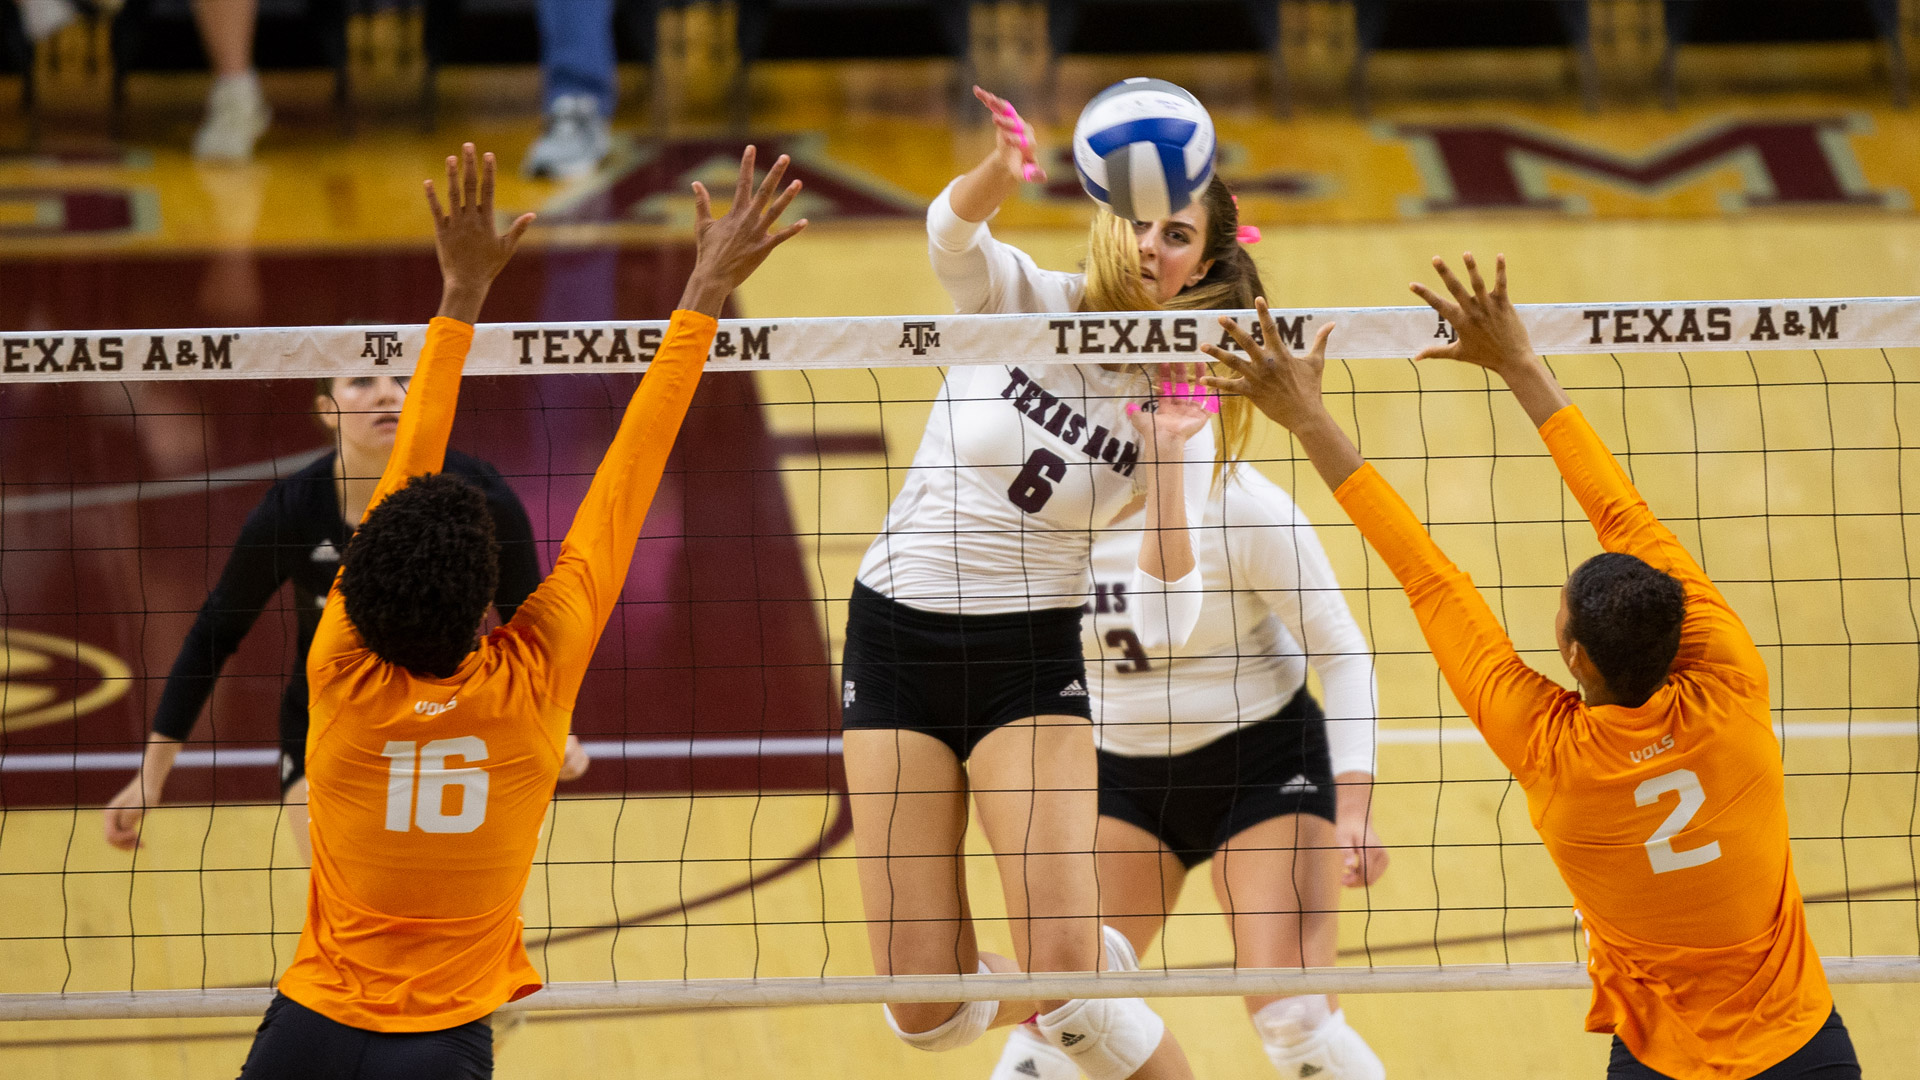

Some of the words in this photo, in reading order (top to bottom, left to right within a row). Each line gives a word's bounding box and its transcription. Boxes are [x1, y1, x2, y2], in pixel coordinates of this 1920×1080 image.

[1049, 318, 1198, 355] TEXAS
[1583, 307, 1731, 344] TEXAS
[1749, 304, 1840, 341] A&M
[142, 334, 233, 370] A&M
[512, 328, 663, 365] TEXAS
[705, 325, 771, 361] &M
[1000, 366, 1087, 445] TEXAS
[1007, 447, 1067, 514] 6
[1105, 628, 1151, 674] 3
[413, 696, 458, 716] VOLS
[1629, 733, 1675, 764] VOLS
[380, 735, 490, 834] 16
[1633, 768, 1722, 875] 2
